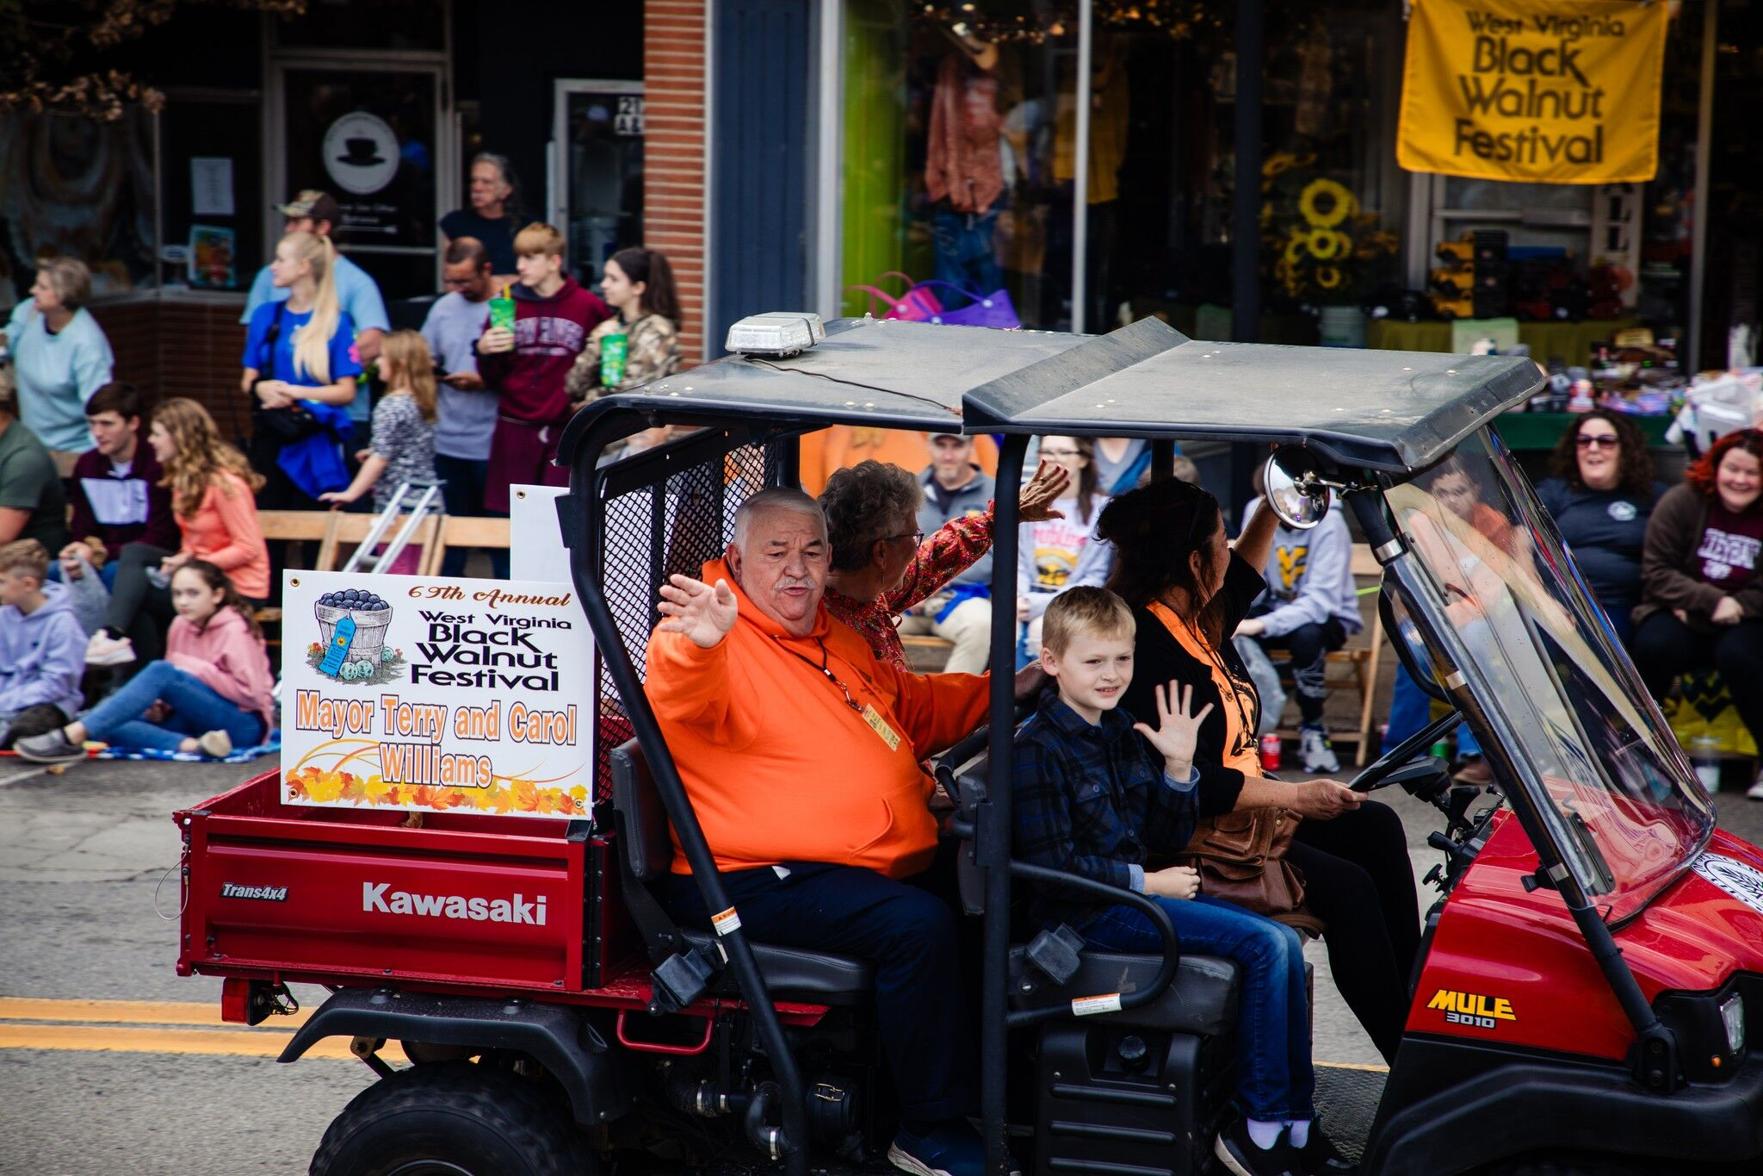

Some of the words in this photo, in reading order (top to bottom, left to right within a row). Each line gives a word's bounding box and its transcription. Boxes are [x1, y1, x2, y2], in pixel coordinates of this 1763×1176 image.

[1466, 10, 1523, 34] West
[1533, 14, 1625, 41] Virginia
[1473, 36, 1590, 88] Black
[1458, 75, 1605, 119] Walnut
[1454, 118, 1603, 164] Festival
[408, 586, 466, 601] 69th
[472, 588, 571, 609] Annual
[418, 610, 475, 625] West
[485, 613, 572, 630] Virginia
[428, 623, 543, 654] Black
[415, 642, 558, 670] Walnut
[411, 663, 560, 692] Festival
[296, 689, 374, 739] Mayor
[381, 694, 447, 745] Terry
[454, 700, 501, 741] and
[508, 701, 577, 745] Carol
[379, 742, 492, 788] Williams
[222, 883, 287, 900] Trans4x4
[362, 882, 546, 926] Kawasaki
[1427, 990, 1516, 1020] MULE
[1446, 1012, 1495, 1028] 3010
